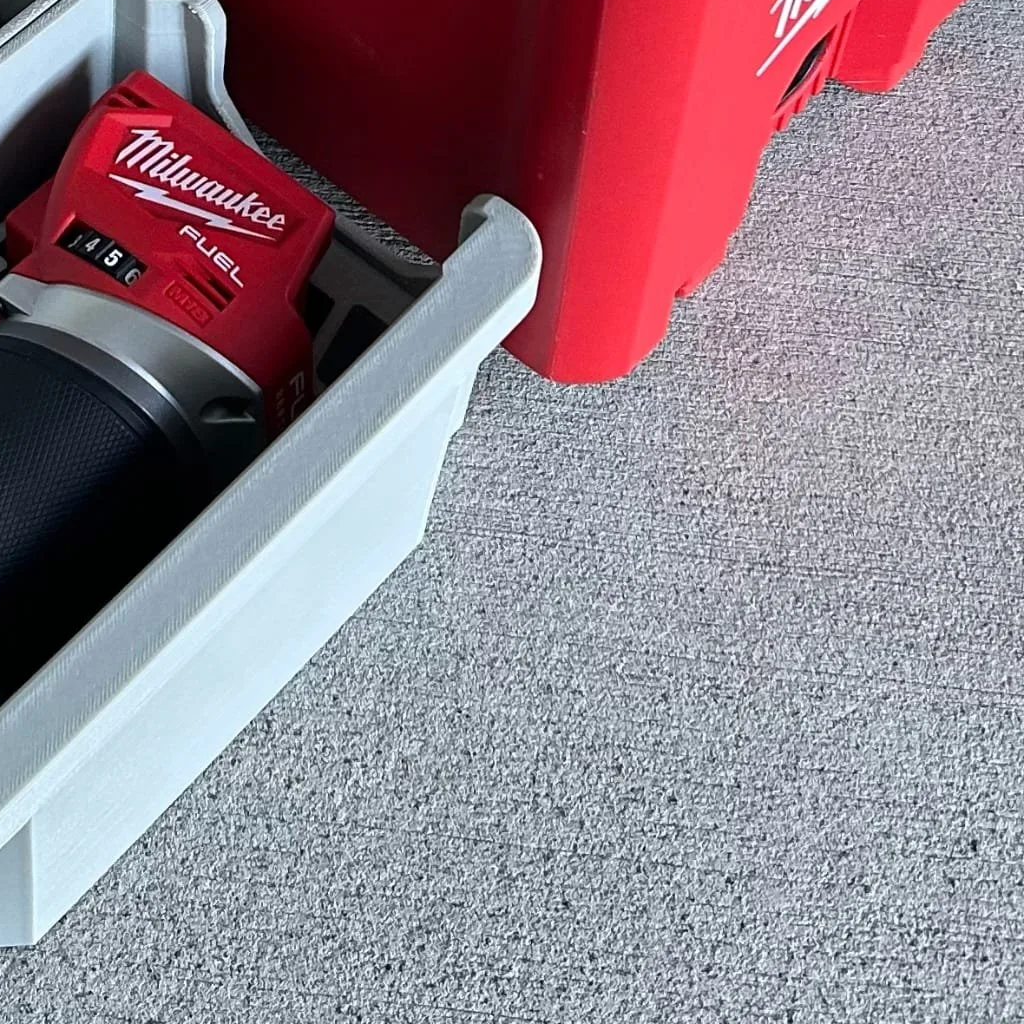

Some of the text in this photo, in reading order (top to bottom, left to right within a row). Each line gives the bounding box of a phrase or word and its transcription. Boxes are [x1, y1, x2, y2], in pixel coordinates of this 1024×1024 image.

[115, 129, 286, 232] Milwaukee
[84, 237, 101, 253] 4
[103, 248, 124, 268] 5
[124, 268, 141, 286] 6
[179, 225, 244, 289] FUEL
